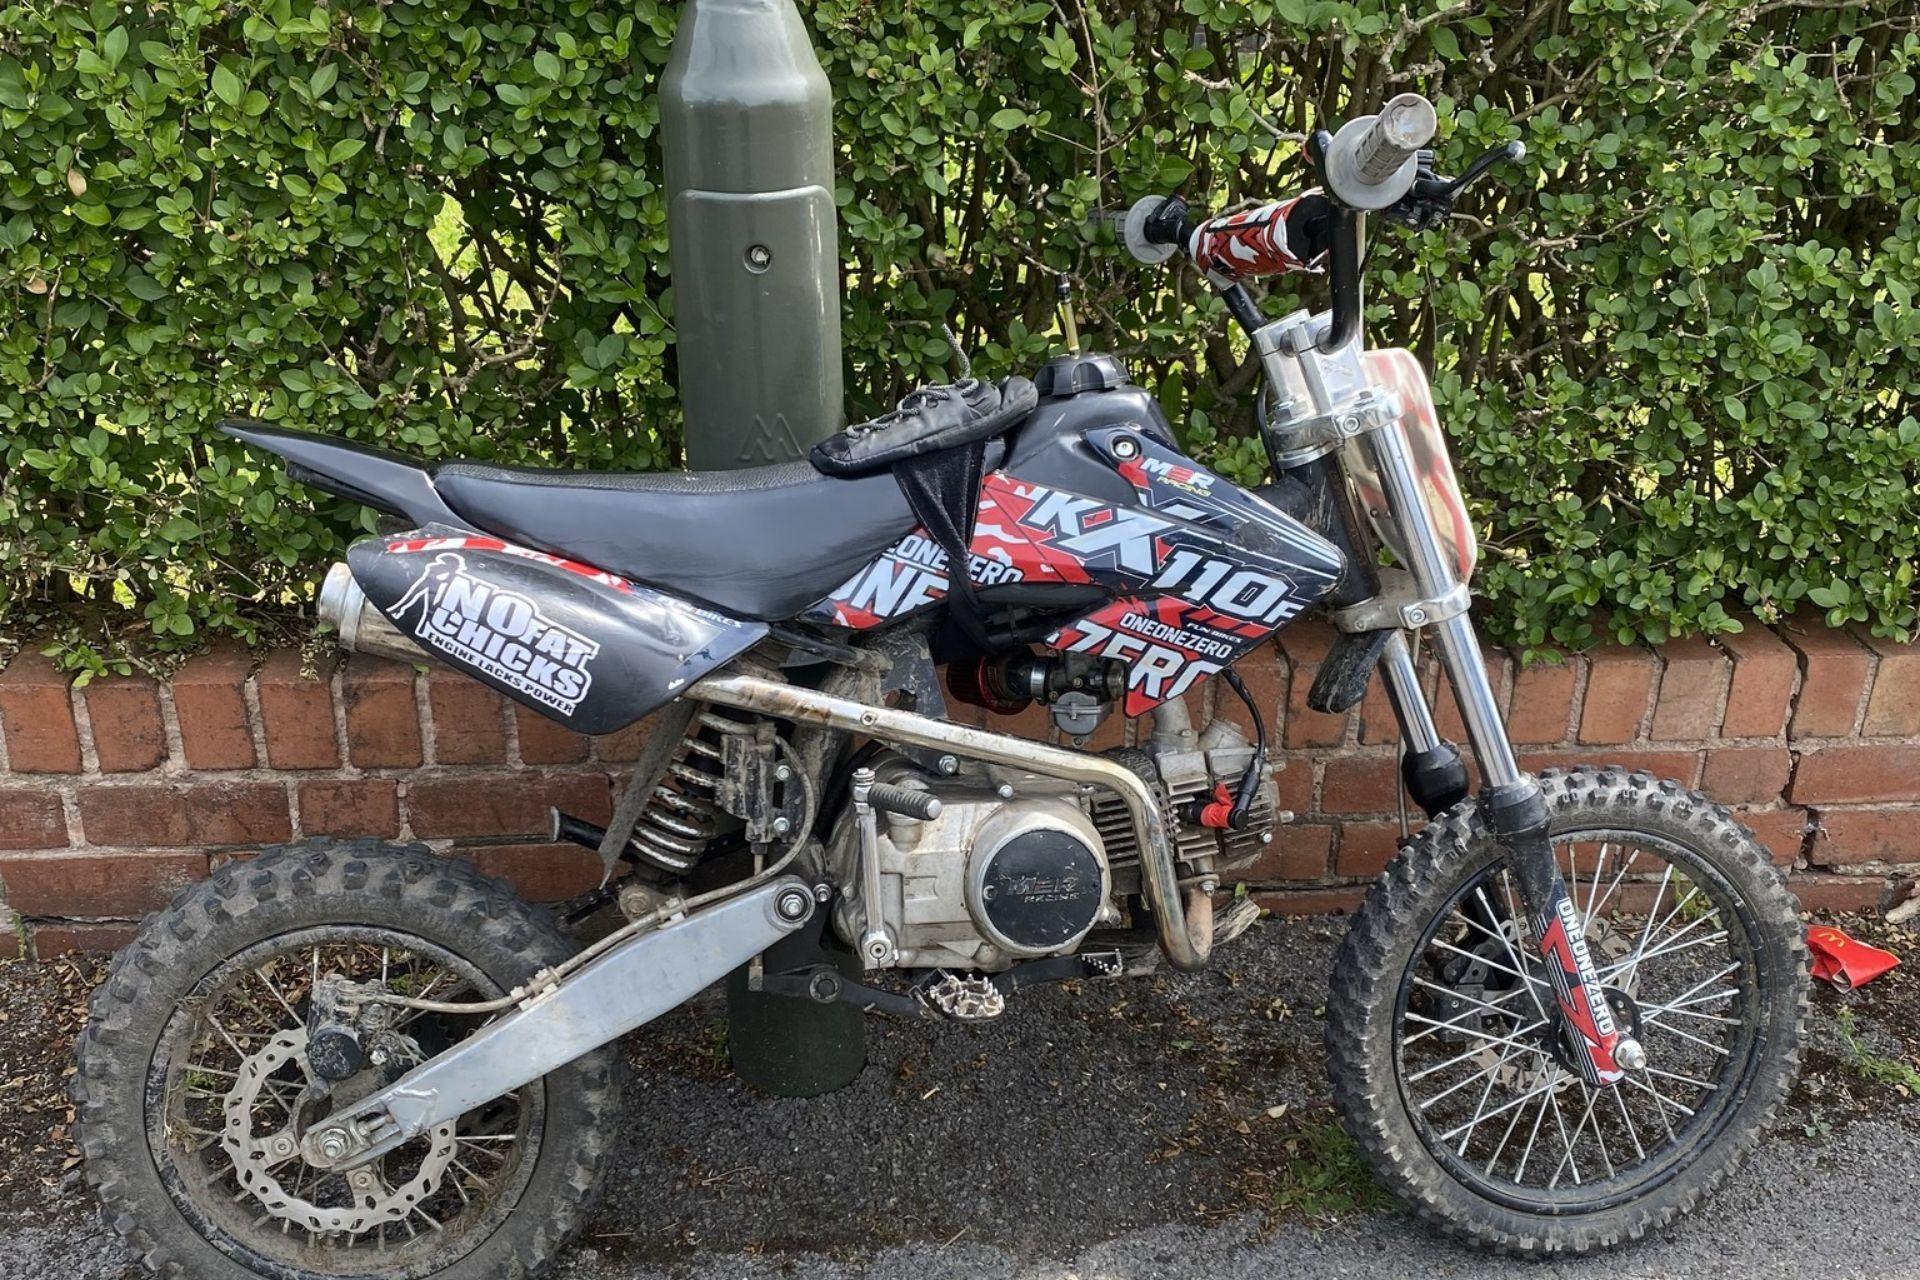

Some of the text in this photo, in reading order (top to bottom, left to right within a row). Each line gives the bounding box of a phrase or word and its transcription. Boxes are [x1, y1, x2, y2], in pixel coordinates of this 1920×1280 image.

[1157, 476, 1212, 497] RACING
[431, 607, 585, 699] CHICKS
[441, 576, 593, 667] NO FAT
[1120, 612, 1233, 660] ONEONEZERO
[1210, 629, 1243, 643] BIKES
[428, 631, 574, 715] ENGINE LACKS POWER
[1557, 901, 1615, 1034] ONEONEZERO
